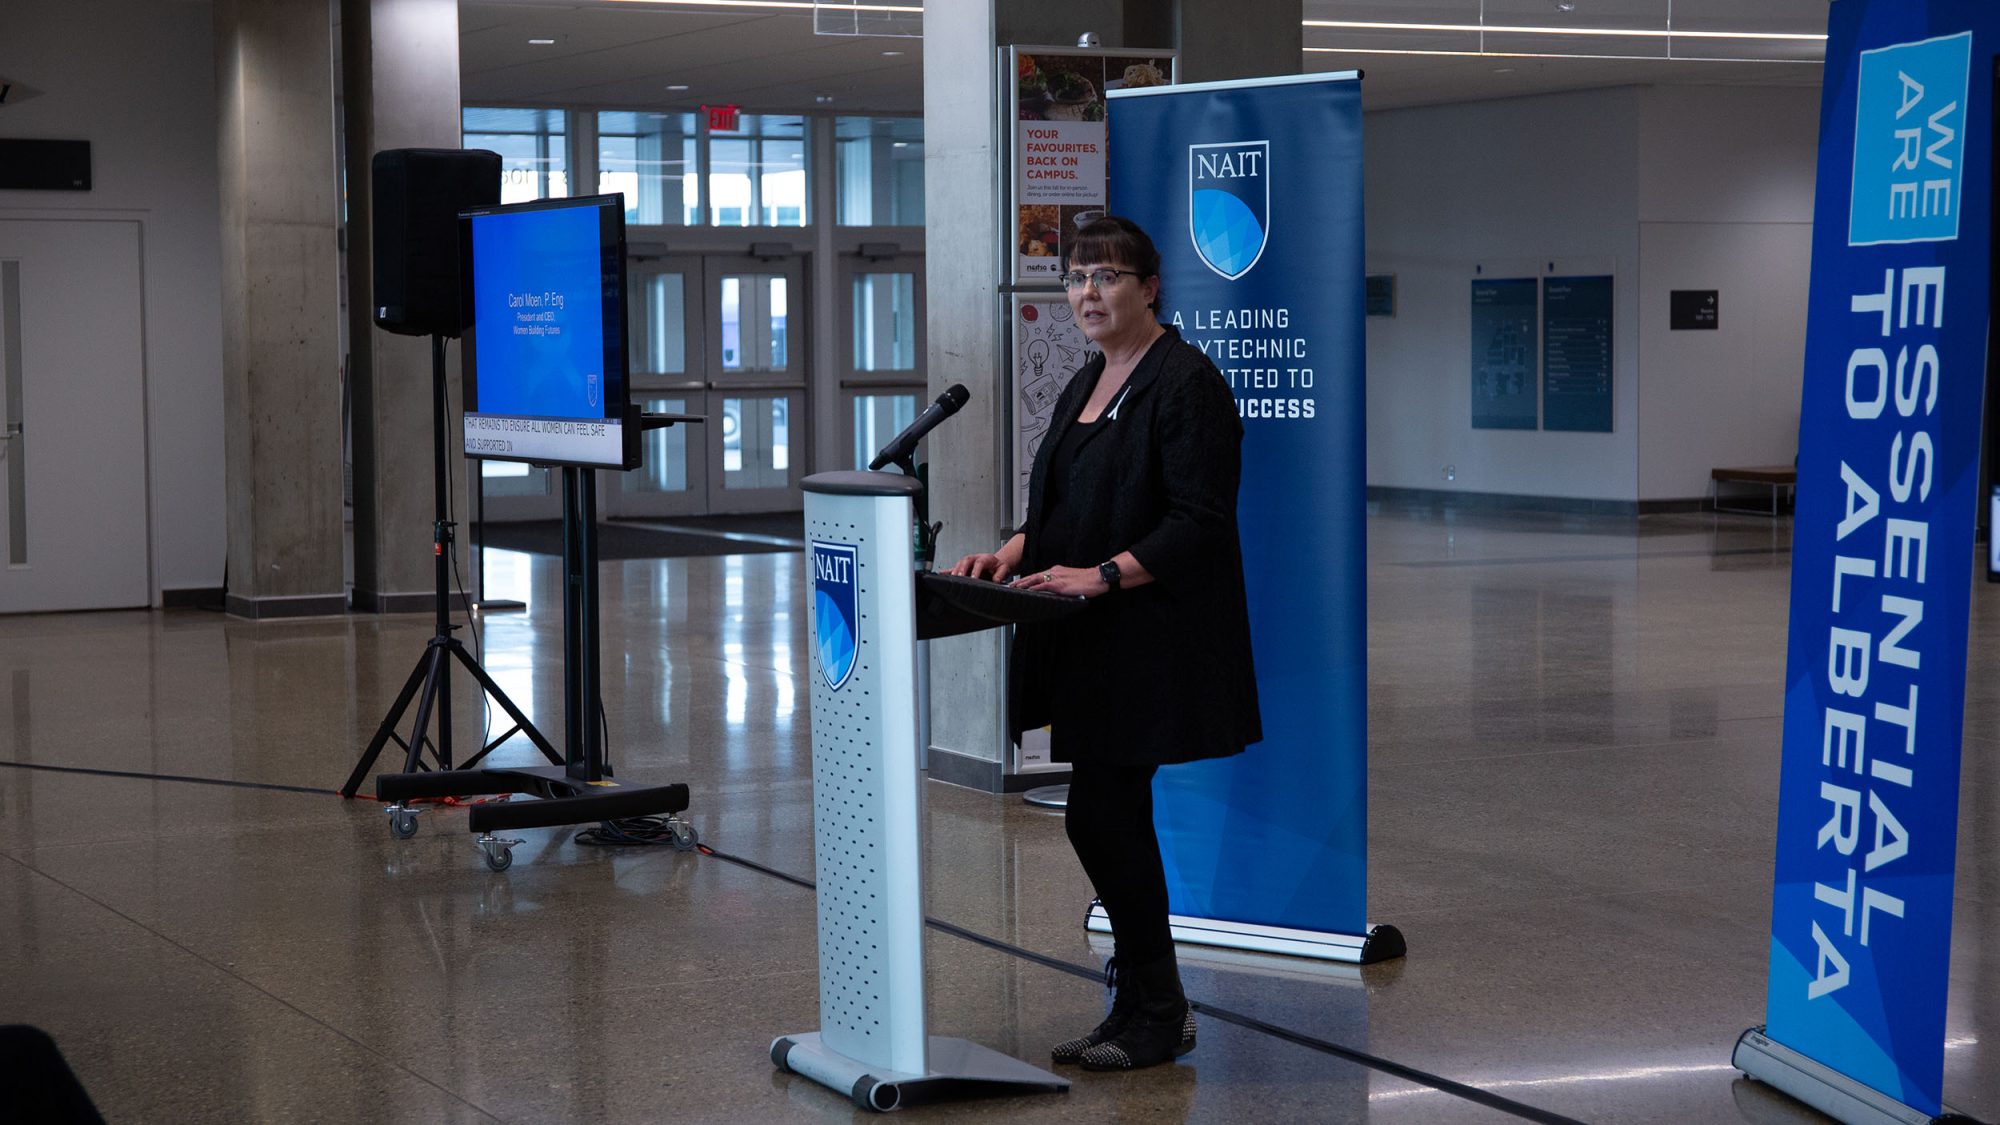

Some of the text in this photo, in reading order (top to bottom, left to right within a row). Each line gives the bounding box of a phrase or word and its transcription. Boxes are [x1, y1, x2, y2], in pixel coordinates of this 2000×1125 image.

[710, 108, 734, 130] EXIT
[1026, 129, 1059, 139] YOUR
[1026, 143, 1099, 154] FAVOURITES,
[1889, 70, 1924, 220] ARE
[1026, 156, 1078, 166] BACK ON
[1197, 151, 1262, 179] NAIT
[1922, 100, 1957, 217] WE
[1026, 170, 1078, 180] CAMPUS.
[508, 291, 564, 310] Carol Moen, P. Eng
[517, 312, 535, 322] President
[1172, 308, 1289, 330] A LEADING
[513, 325, 560, 337] Women Building Futures
[1197, 338, 1306, 359] YTECHNIC
[1287, 368, 1313, 388] TO
[1235, 398, 1315, 419] UCCESS
[465, 417, 605, 437] THAT REMAINS TO ENSURE ALL WOMEN CAN FEEL SAFE
[465, 438, 513, 452] AND SUPPORTED IN
[815, 552, 851, 584] NAIT
[1860, 265, 1946, 947] ESSENTIAL
[1808, 268, 1895, 1001] TO ALBERTA
